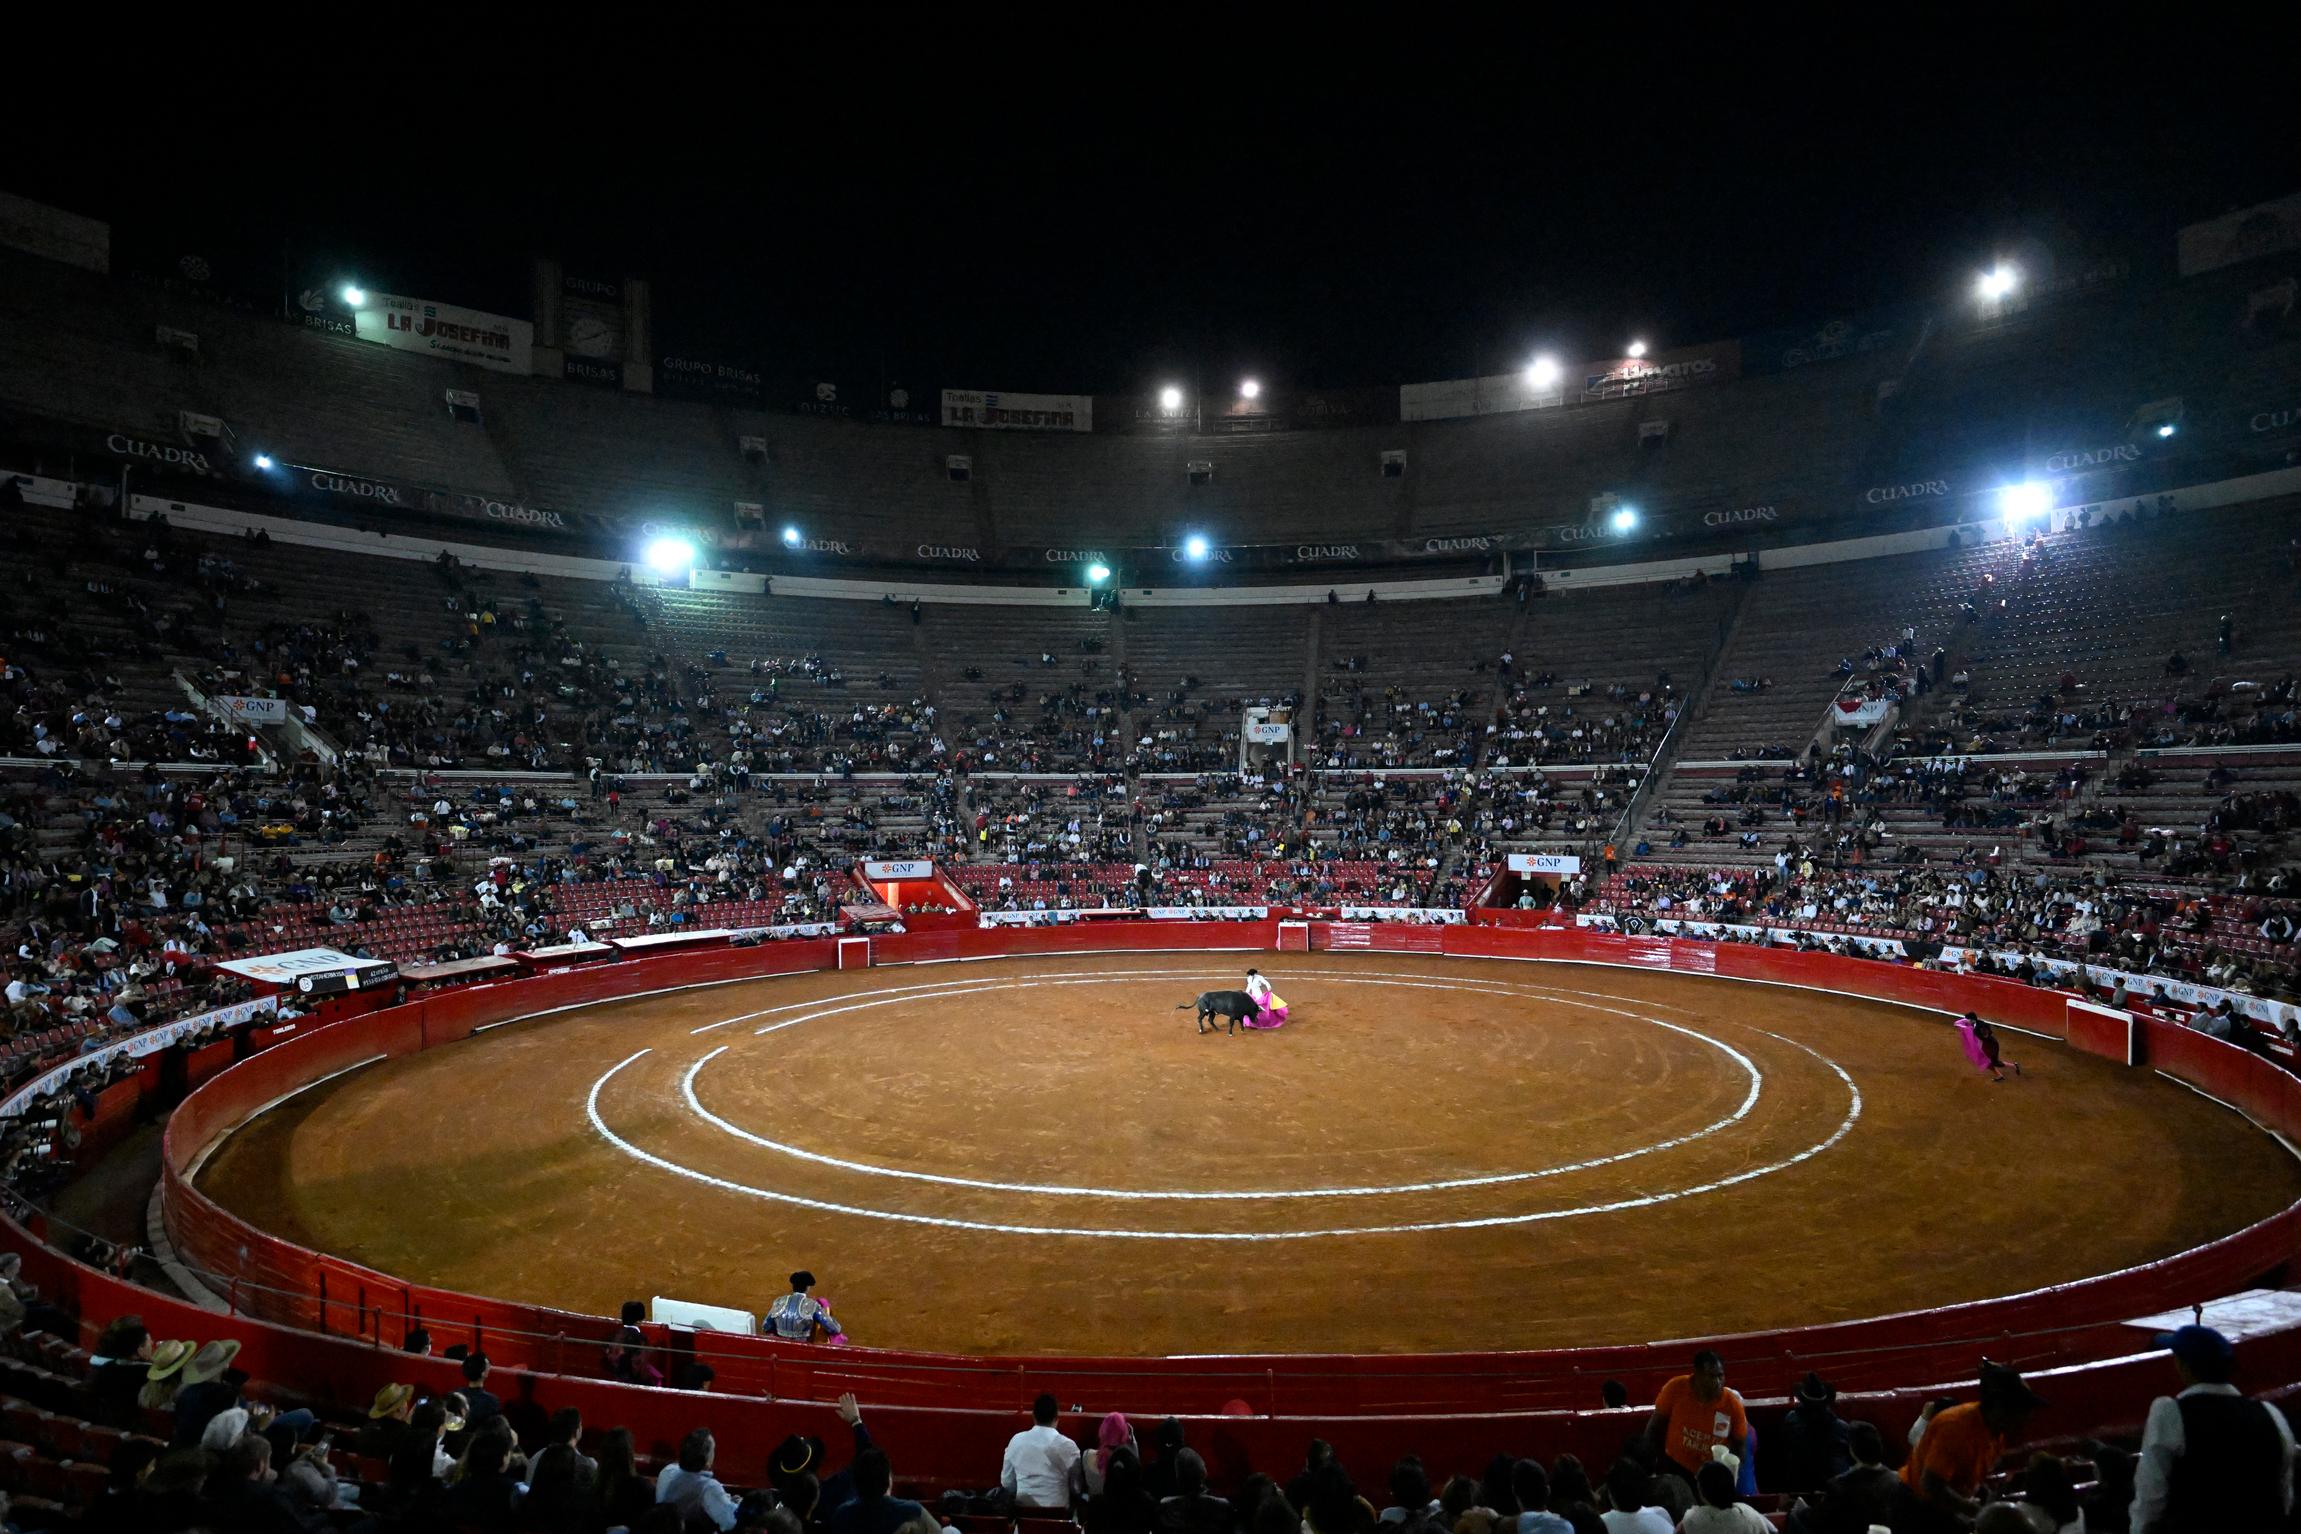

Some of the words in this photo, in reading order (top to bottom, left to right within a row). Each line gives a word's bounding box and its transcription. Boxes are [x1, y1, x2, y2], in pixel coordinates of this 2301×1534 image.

[304, 314, 353, 335] BRISAS
[387, 312, 412, 332] LA
[567, 361, 617, 382] BRISAS
[663, 356, 712, 374] GRUPO
[717, 364, 760, 385] BRISAS
[951, 406, 974, 422] LA
[106, 434, 209, 479] CUADRA
[2046, 443, 2142, 473] CUADRA
[310, 473, 400, 505] CUADRA
[1866, 479, 1949, 504] CUADRA
[484, 501, 565, 528] CUADRA
[1703, 505, 1779, 527] CUADRA
[1298, 544, 1360, 560] CUADRA
[1425, 536, 1491, 552] CUADRA
[916, 543, 981, 562] CUADRA
[1045, 548, 1106, 563] CUADRA
[246, 701, 275, 712] GNP
[1261, 726, 1281, 734] GNP
[891, 863, 914, 873] GNP
[1537, 857, 1561, 867] GNP
[277, 954, 343, 971] GNP
[2127, 976, 2143, 986] GNP
[2178, 987, 2195, 997] GNP
[2204, 992, 2220, 1002] GNP
[240, 1002, 254, 1016] GNP
[261, 999, 275, 1010] GNP
[218, 1010, 232, 1022] GNP
[133, 1036, 148, 1049] GNP
[154, 1030, 169, 1043] GNP
